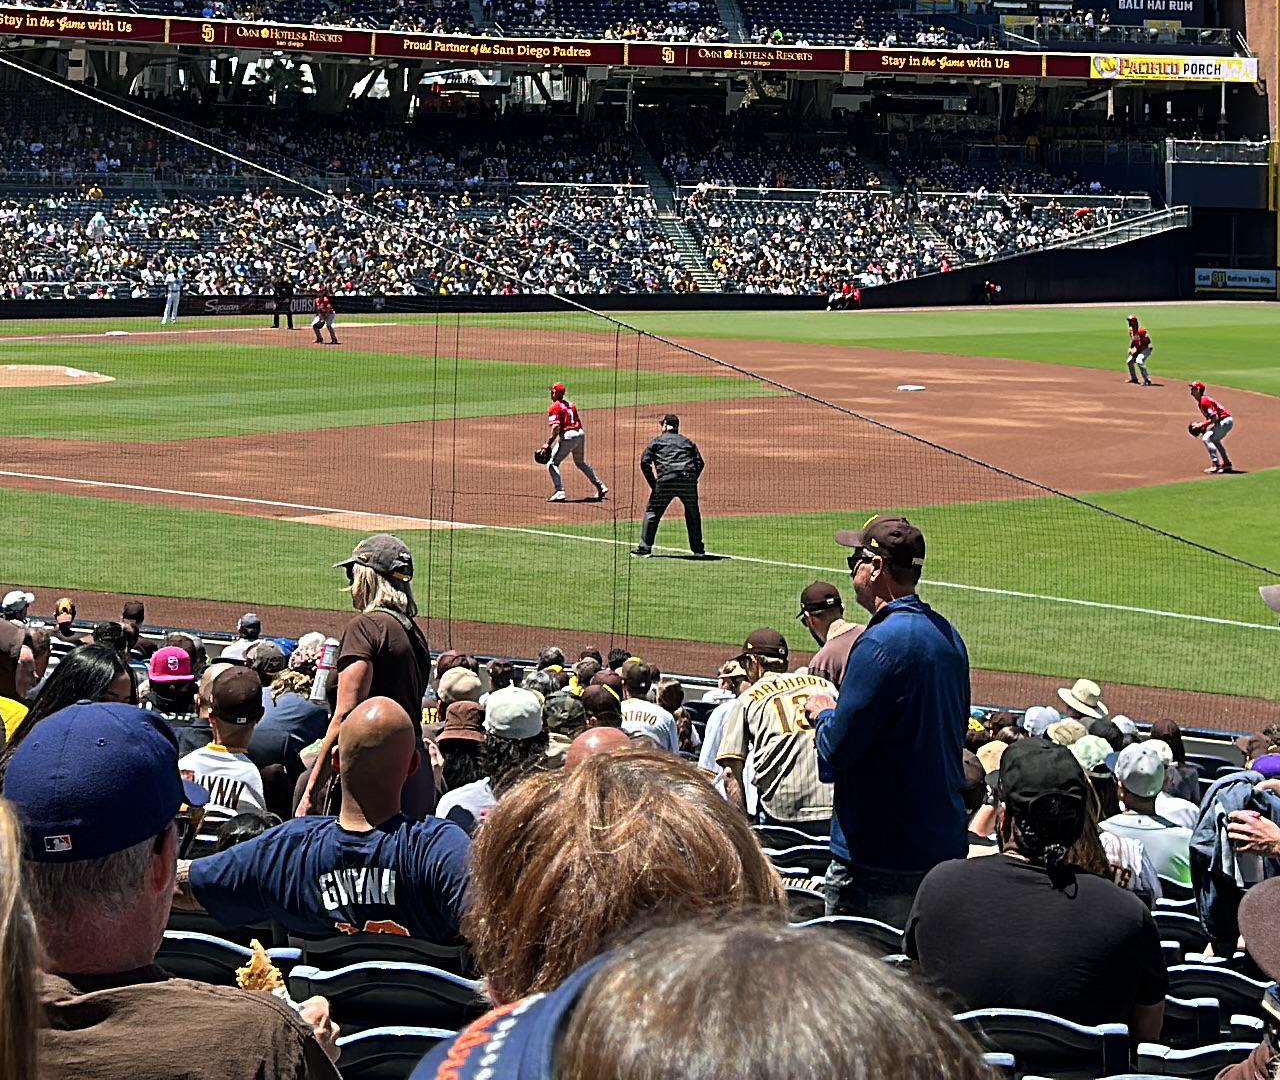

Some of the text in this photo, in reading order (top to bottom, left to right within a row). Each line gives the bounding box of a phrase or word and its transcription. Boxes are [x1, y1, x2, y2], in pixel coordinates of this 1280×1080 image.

[1147, 0, 1166, 10] HAI
[1169, 0, 1193, 11] RUM
[26, 14, 38, 26] in
[40, 16, 54, 28] the
[56, 16, 86, 31] Game
[88, 19, 114, 32] with
[117, 21, 132, 33] Us
[404, 39, 591, 58] Proud Partner the San Diego Padres
[882, 55, 1010, 69] Stay in the Game with Us
[1183, 63, 1221, 76] PORCH
[748, 676, 827, 702] MACHADO
[320, 867, 396, 910] GWYNN
